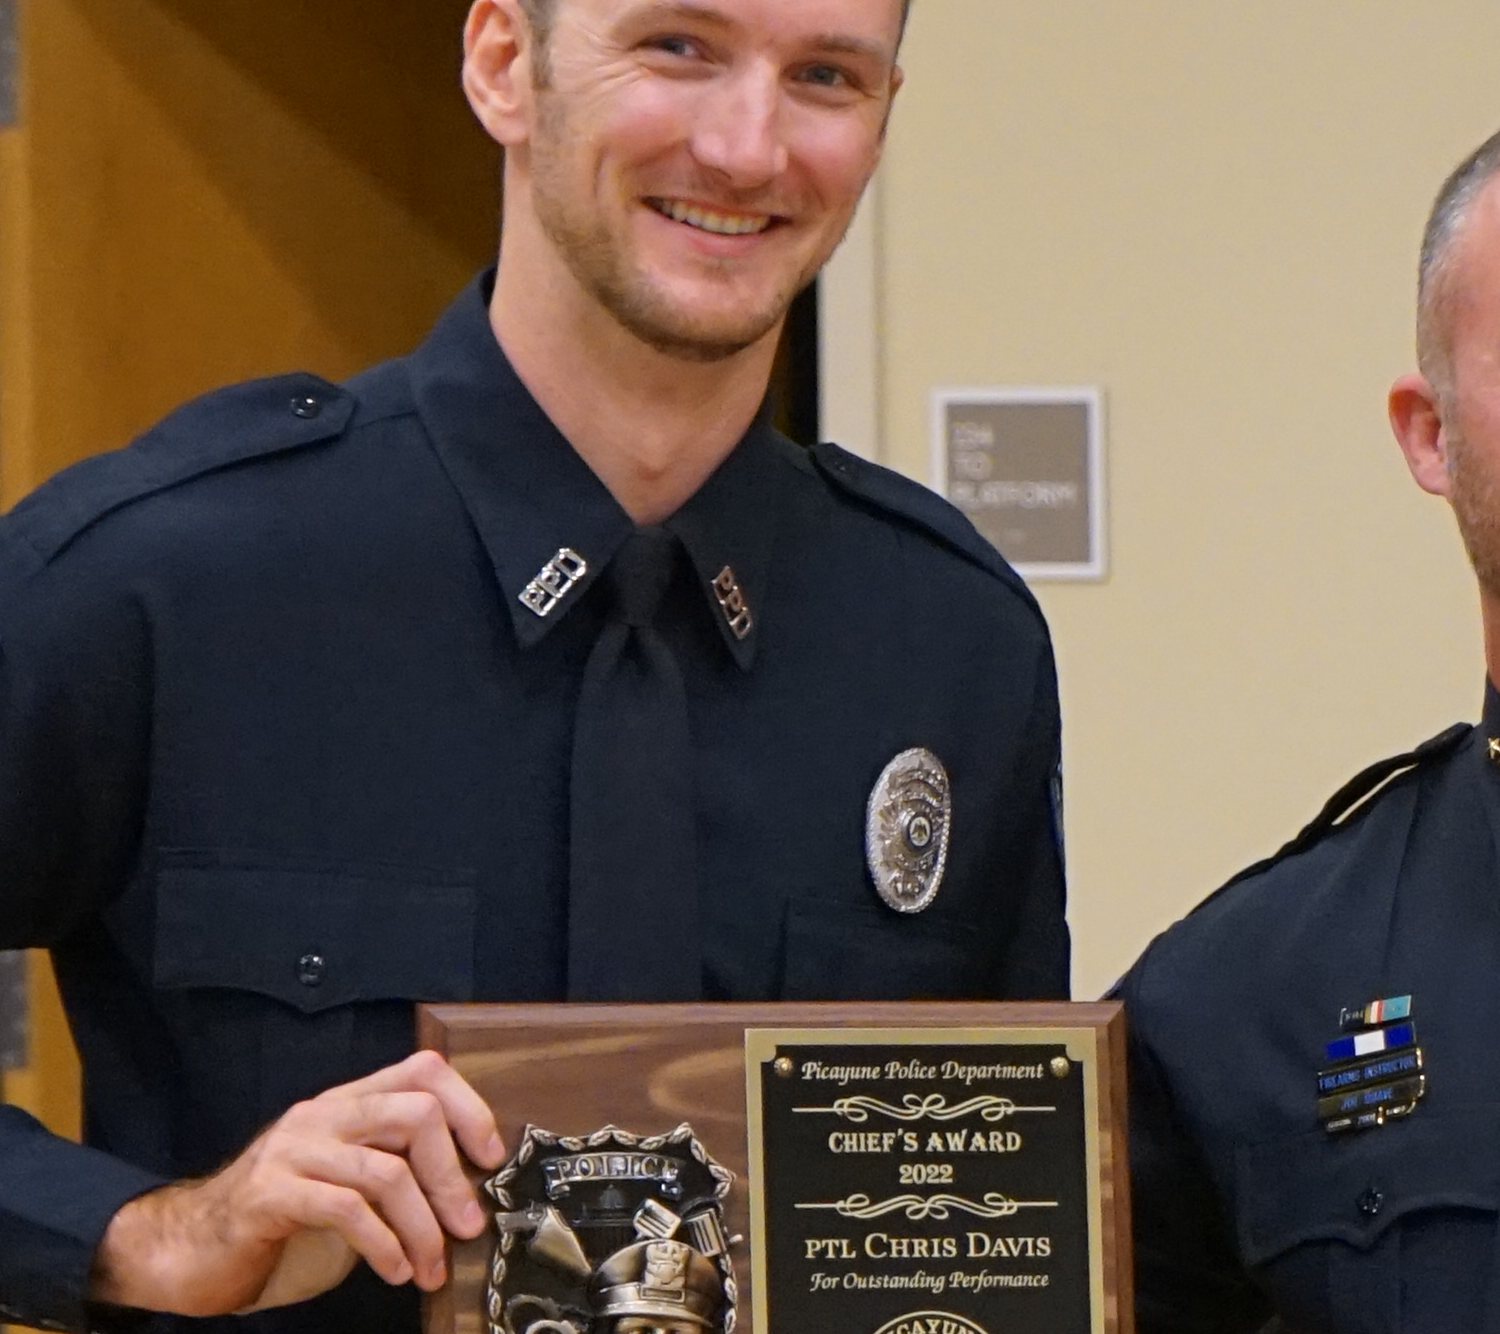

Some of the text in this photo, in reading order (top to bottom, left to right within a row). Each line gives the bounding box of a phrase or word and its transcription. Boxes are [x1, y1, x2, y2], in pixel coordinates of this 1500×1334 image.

[801, 1059, 1044, 1085] Picayune Police Department
[828, 1128, 1022, 1153] CHIEF'S AWARD
[556, 1155, 678, 1182] POLICE
[899, 1164, 953, 1185] 2022
[805, 1232, 1051, 1259] PTL CHRIS DAVIS
[810, 1269, 1049, 1294] For Outstanding Performance
